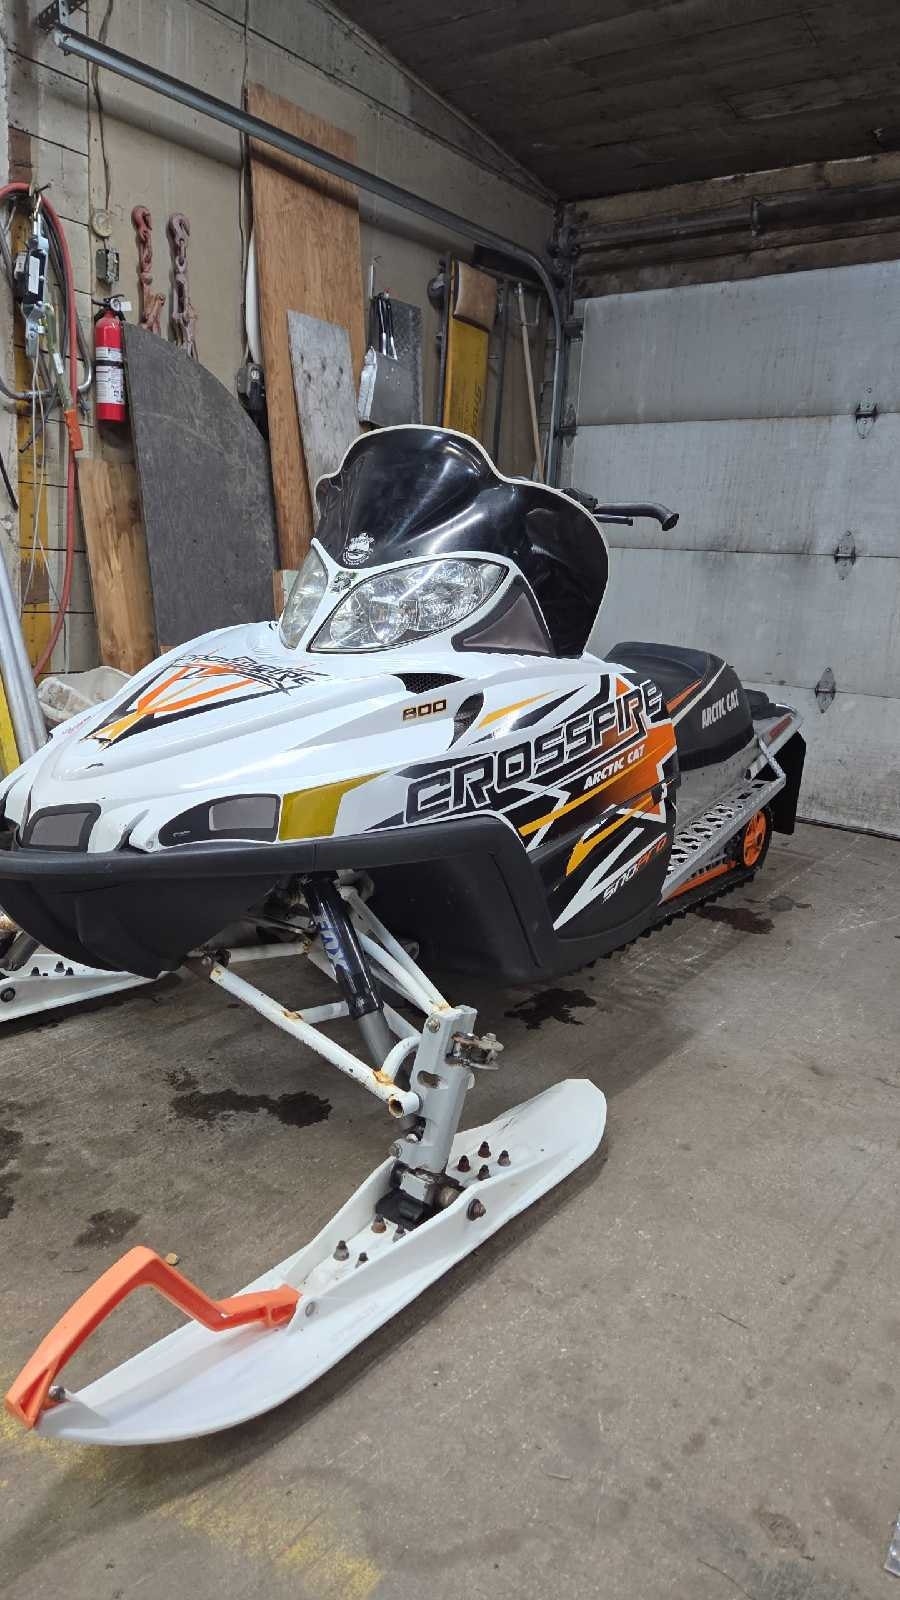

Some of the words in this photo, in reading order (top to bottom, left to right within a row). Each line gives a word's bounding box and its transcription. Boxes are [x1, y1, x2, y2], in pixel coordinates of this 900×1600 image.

[402, 699, 447, 721] 800
[702, 697, 726, 729] ARCTIC
[726, 688, 740, 712] CAT
[404, 680, 663, 824] CROSSFIRE
[583, 757, 625, 790] ARCTIC
[627, 743, 646, 764] CAT
[312, 914, 350, 973] FOX
